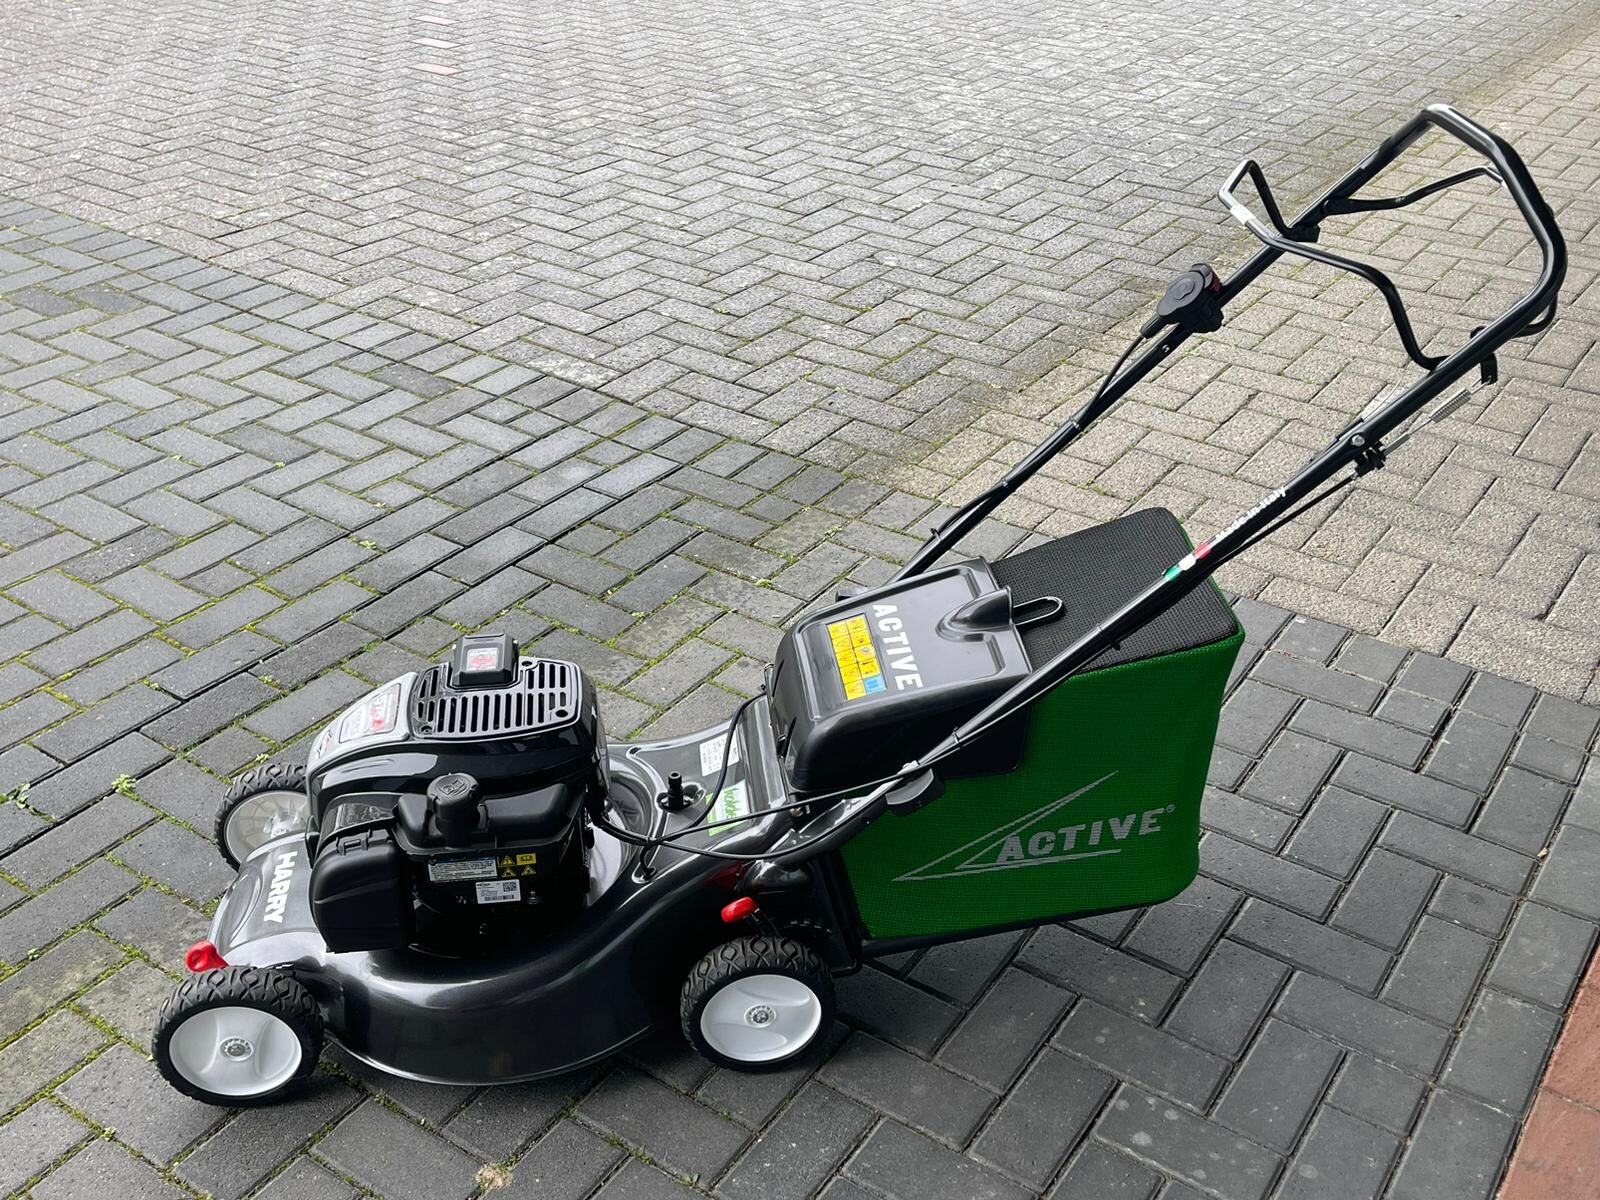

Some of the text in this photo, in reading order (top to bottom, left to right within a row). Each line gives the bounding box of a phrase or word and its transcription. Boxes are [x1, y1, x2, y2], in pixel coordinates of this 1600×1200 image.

[872, 604, 923, 690] ACTIVE
[996, 807, 1165, 864] ACTIVE
[263, 850, 298, 923] HARRY
